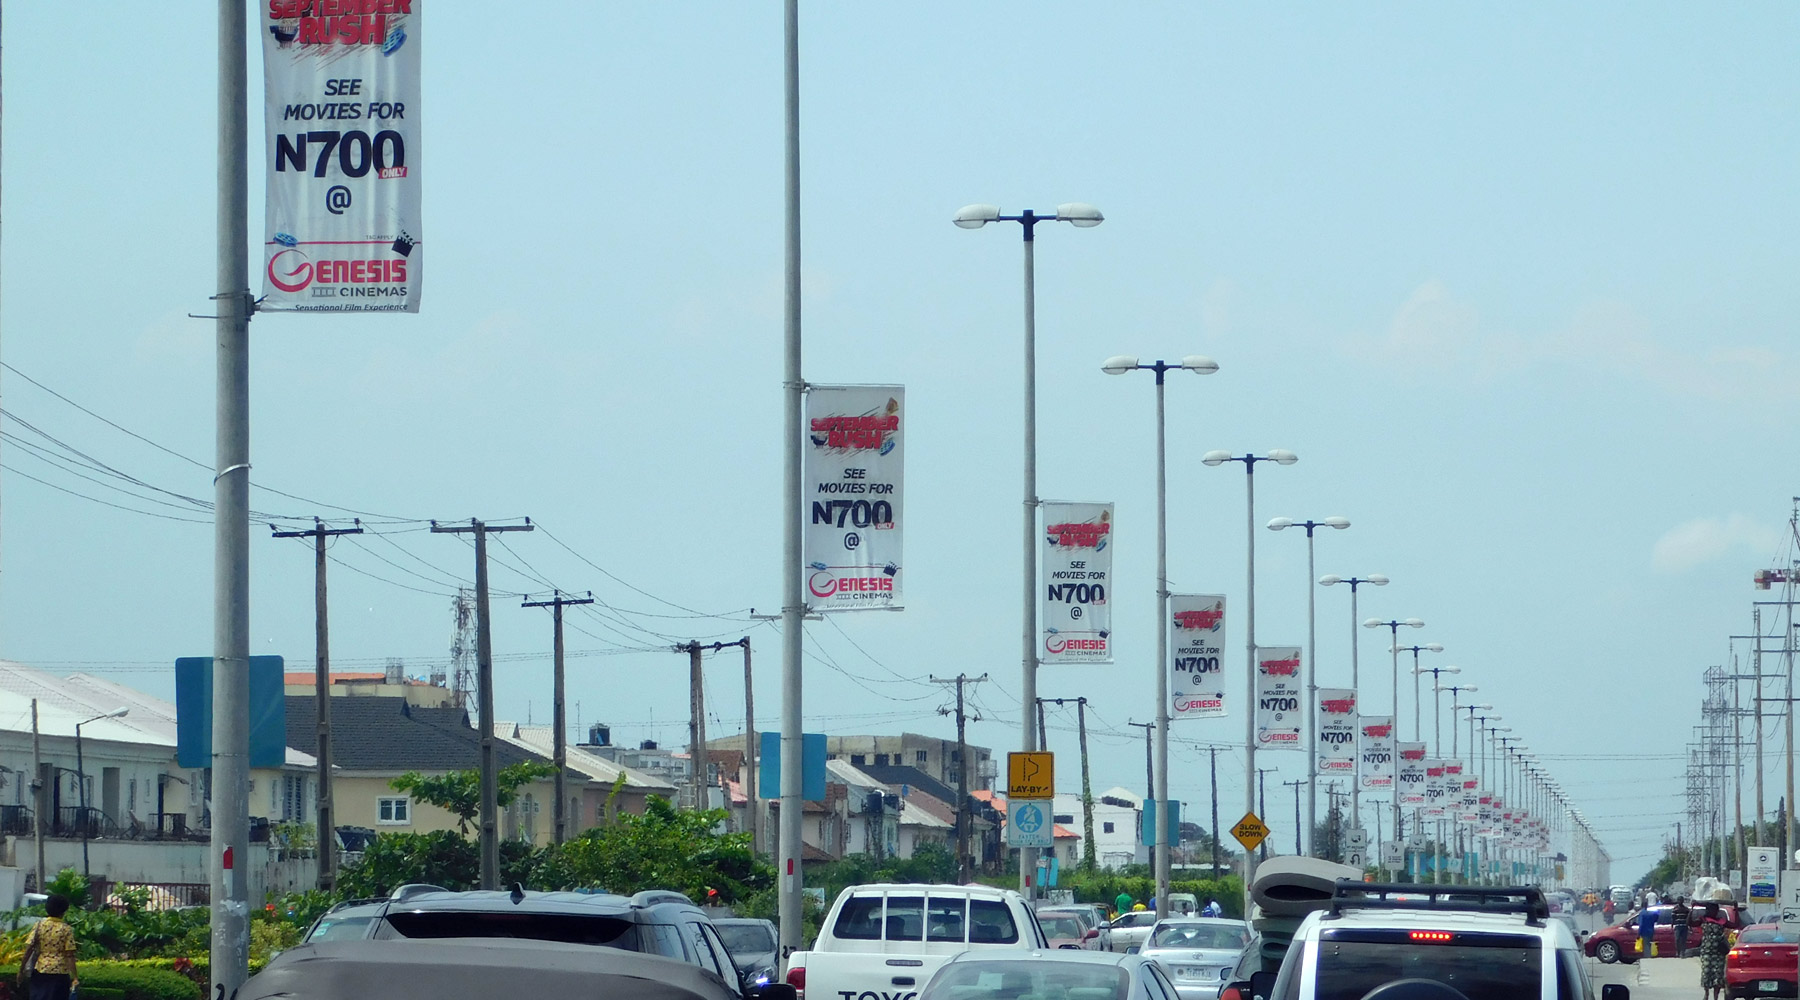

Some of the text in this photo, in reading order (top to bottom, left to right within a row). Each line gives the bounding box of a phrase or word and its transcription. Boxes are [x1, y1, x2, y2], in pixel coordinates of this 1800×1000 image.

[269, 0, 412, 19] SEPTEMBER
[299, 15, 387, 45] RUSH
[324, 79, 362, 96] SEE
[284, 102, 405, 121] MOVIES FOR
[275, 130, 405, 178] N700
[381, 167, 406, 178] ONLY
[326, 185, 352, 215] @
[340, 286, 408, 297] CINEMAS
[344, 304, 362, 312] Film
[364, 303, 408, 312] Experience
[811, 415, 899, 432] SEPTEMBER
[828, 431, 883, 449] RUSH
[844, 468, 866, 479] SEE
[818, 483, 893, 494] MOVIES FOR
[812, 500, 893, 528] N700
[844, 532, 860, 550] @
[1070, 561, 1086, 569] SEE
[1052, 571, 1105, 580] MOVIES FOR
[1048, 583, 1104, 604] N700
[1070, 606, 1083, 620] @
[1175, 657, 1219, 673] N700
[1192, 675, 1202, 685] @
[1260, 698, 1298, 712] N700
[1275, 713, 1282, 721] @
[1321, 732, 1352, 744] N700
[1363, 754, 1390, 764] N700
[1011, 785, 1042, 793] LAY-BY
[1426, 790, 1444, 798] 700
